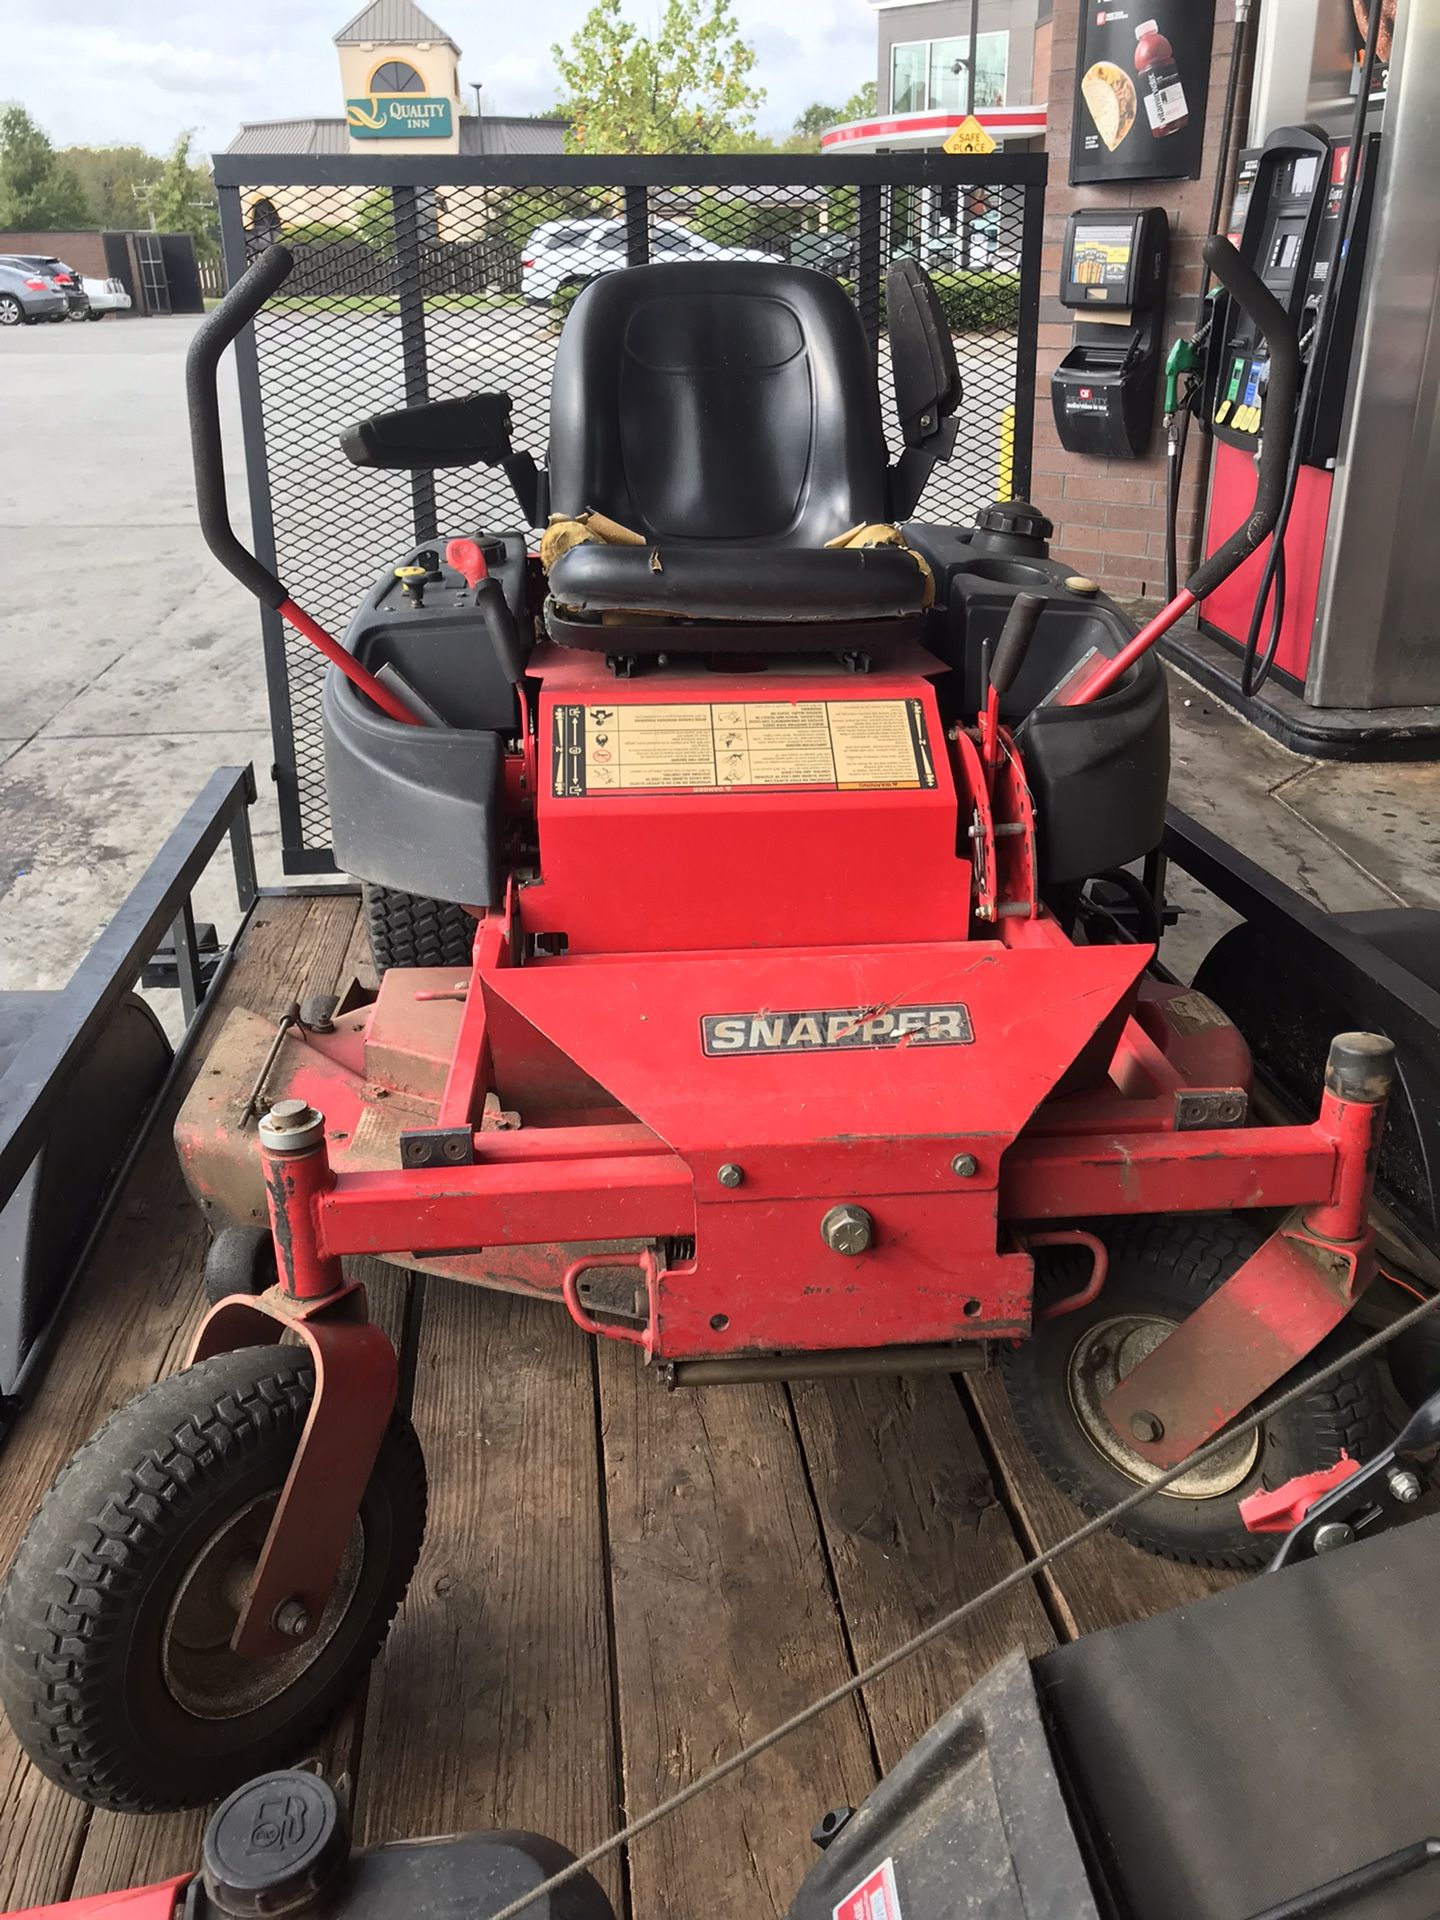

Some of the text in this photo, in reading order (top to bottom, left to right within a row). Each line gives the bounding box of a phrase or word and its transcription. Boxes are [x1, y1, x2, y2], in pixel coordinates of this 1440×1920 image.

[389, 102, 445, 120] QUALITY
[407, 119, 430, 128] INN
[959, 133, 981, 142] SAFE
[711, 1009, 963, 1050] SNAPPER
